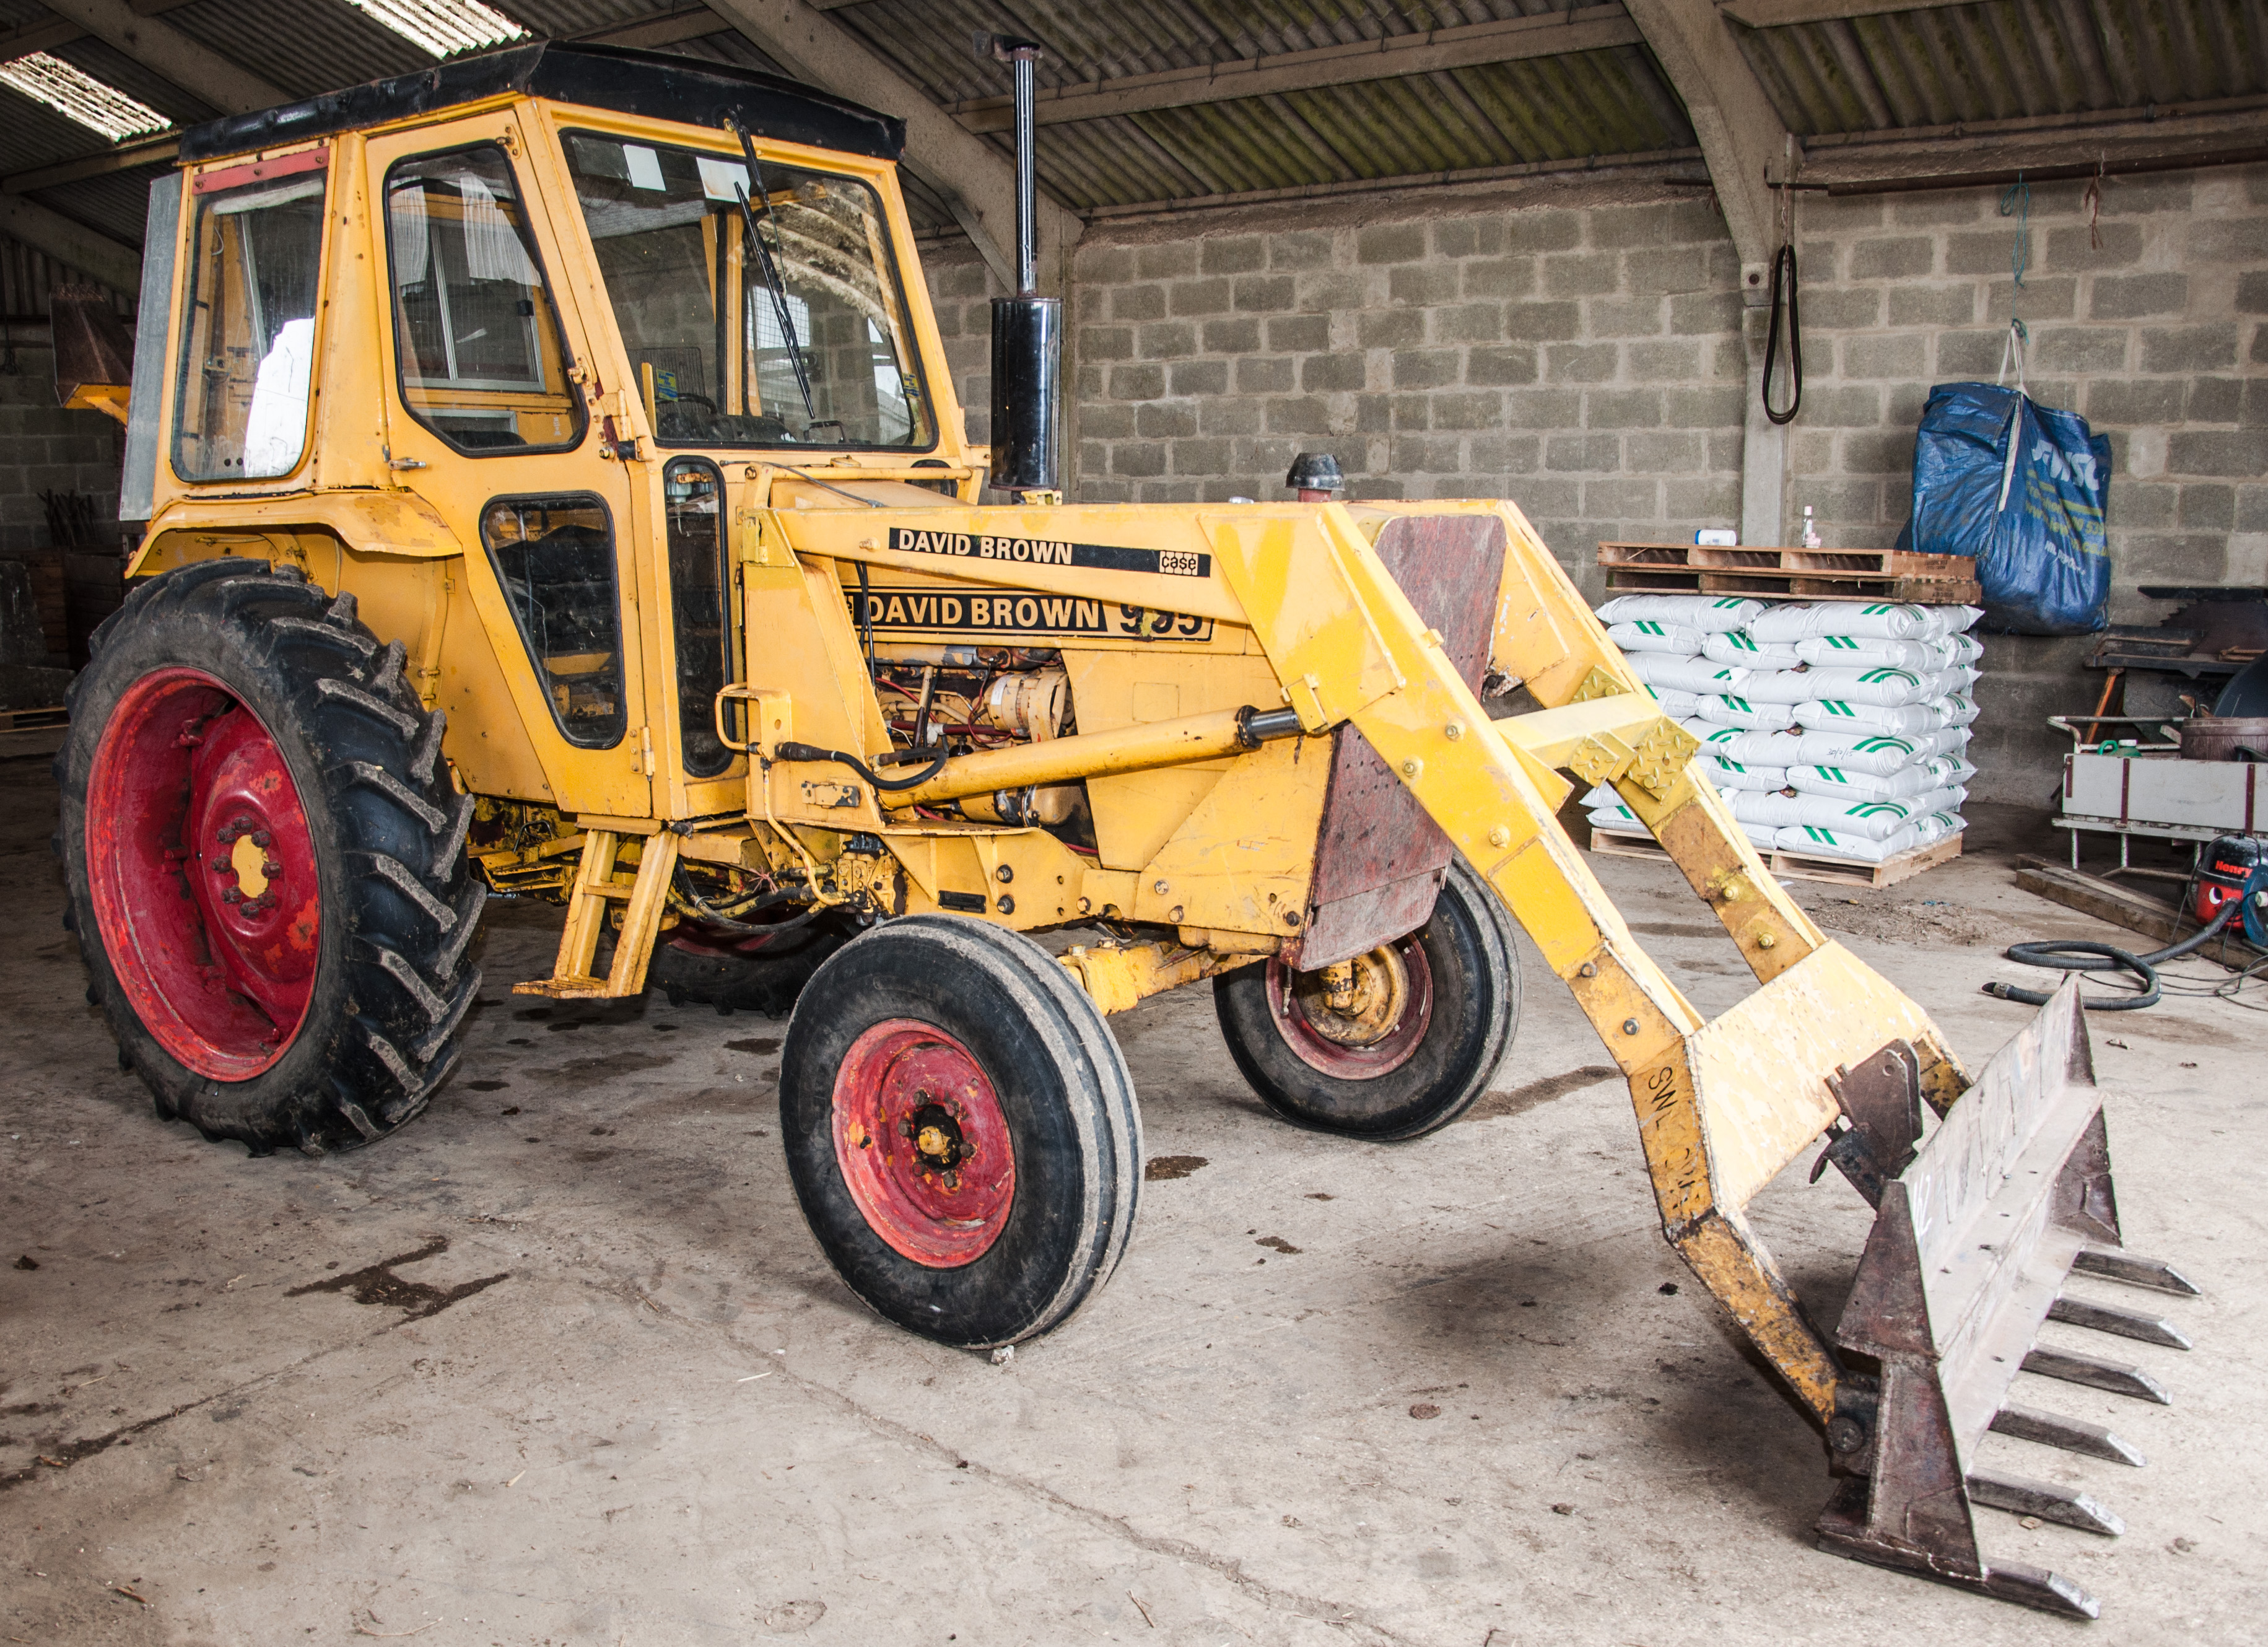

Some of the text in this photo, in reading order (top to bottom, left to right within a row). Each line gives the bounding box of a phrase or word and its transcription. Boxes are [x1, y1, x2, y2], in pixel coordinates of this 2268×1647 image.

[899, 529, 1197, 572] DAVID BROWN case
[868, 596, 962, 624] DAVID
[970, 598, 1099, 628] BROWN
[2215, 860, 2253, 878] Henry
[1648, 1067, 1678, 1130] SWL
